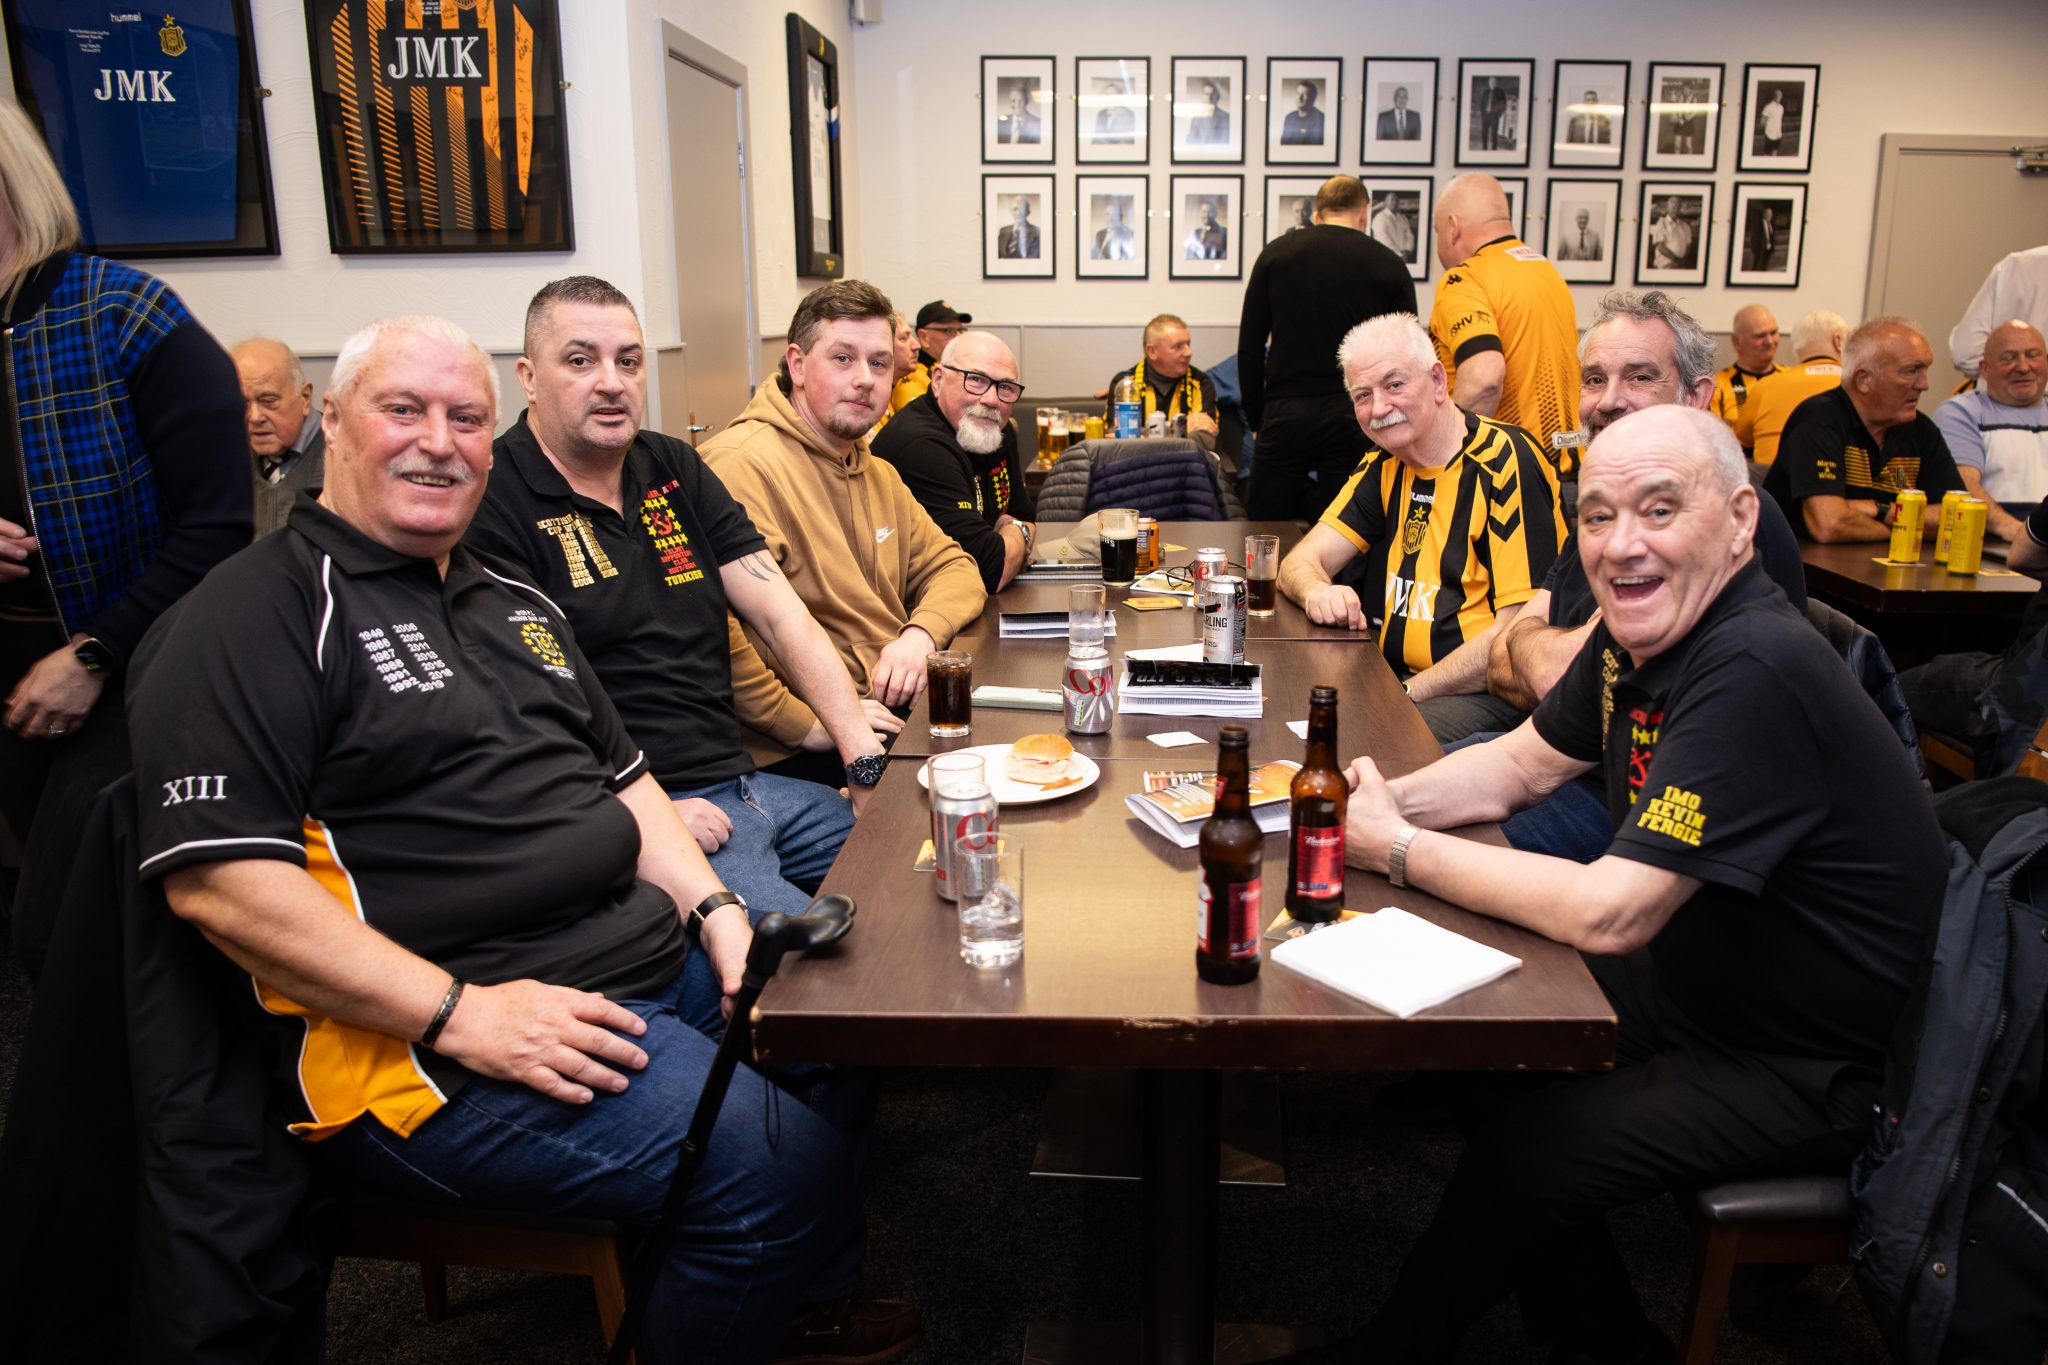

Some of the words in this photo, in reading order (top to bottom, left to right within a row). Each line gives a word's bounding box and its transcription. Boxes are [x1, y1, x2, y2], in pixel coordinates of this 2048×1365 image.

[110, 12, 142, 22] hummel
[388, 36, 482, 79] JMK
[94, 69, 176, 102] JMK
[661, 480, 680, 494] AYR
[537, 514, 573, 529] SCOTTISH
[547, 526, 562, 536] CUP
[572, 576, 595, 588] 2006
[664, 569, 704, 586] TURKISH
[1385, 571, 1440, 621] MK
[358, 628, 385, 641] 1949
[392, 622, 418, 634] 2006
[1204, 615, 1228, 628] RLING
[364, 638, 391, 652] 1986
[400, 632, 425, 643] 2009
[370, 648, 396, 663] 1987
[407, 641, 431, 653] 2011
[376, 658, 404, 674] 1988
[414, 650, 438, 662] 2013
[382, 668, 411, 684] 1991
[421, 660, 446, 671] 2015
[389, 676, 421, 693] 1992
[428, 668, 454, 681] 2018
[418, 679, 445, 693] 2019
[162, 775, 228, 807] XIII
[1663, 785, 1702, 811] IMO
[1647, 797, 1707, 830] KEVIN
[1637, 811, 1703, 847] FERGIE
